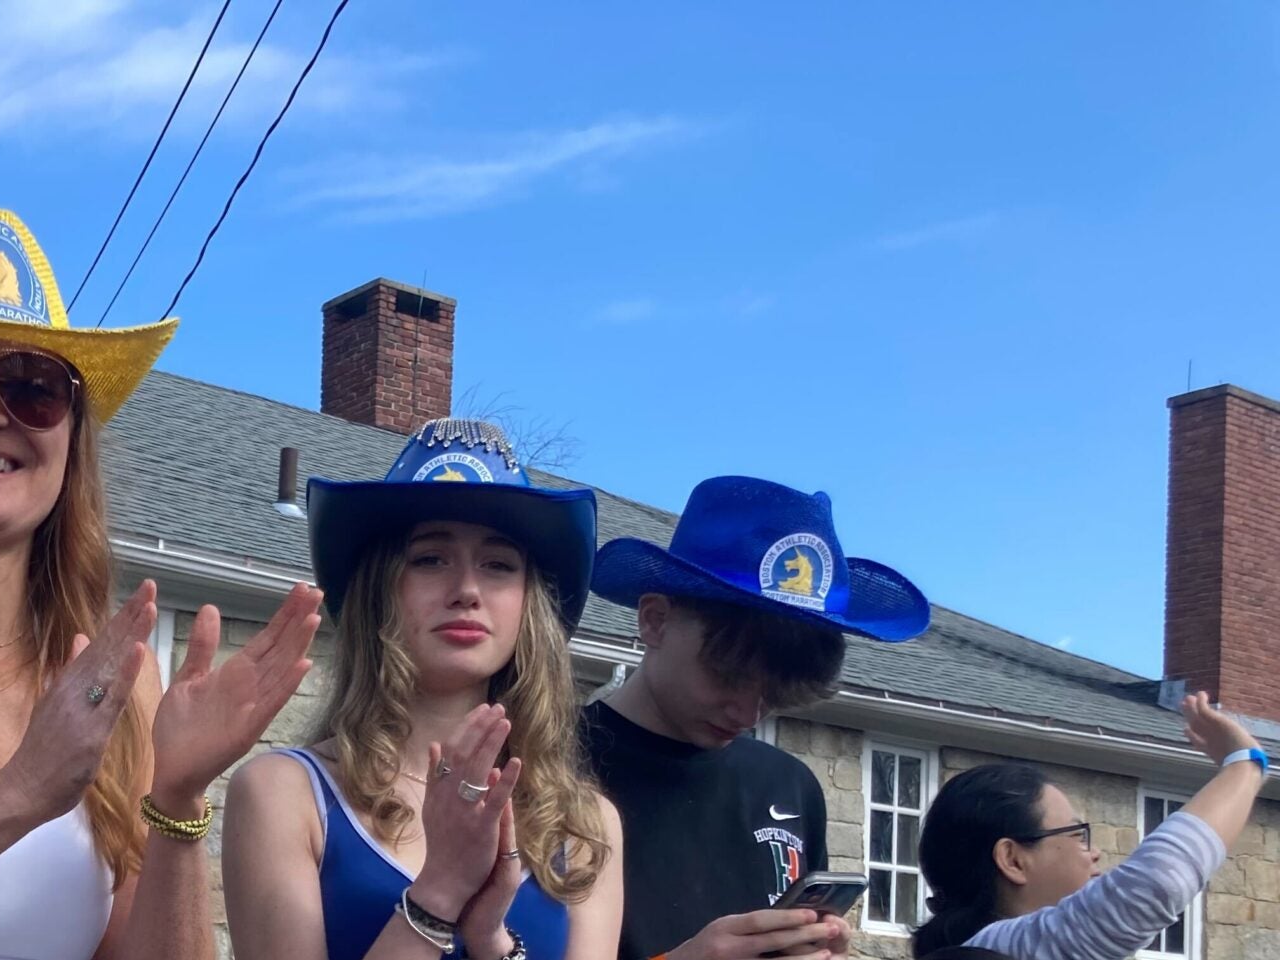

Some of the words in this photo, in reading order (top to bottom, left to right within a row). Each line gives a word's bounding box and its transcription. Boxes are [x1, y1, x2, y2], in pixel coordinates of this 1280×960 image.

[424, 454, 468, 471] ATHLETIC
[762, 551, 777, 585] BOSTON
[776, 535, 816, 552] ATHLETIC
[814, 541, 832, 594] ASSOCIATION
